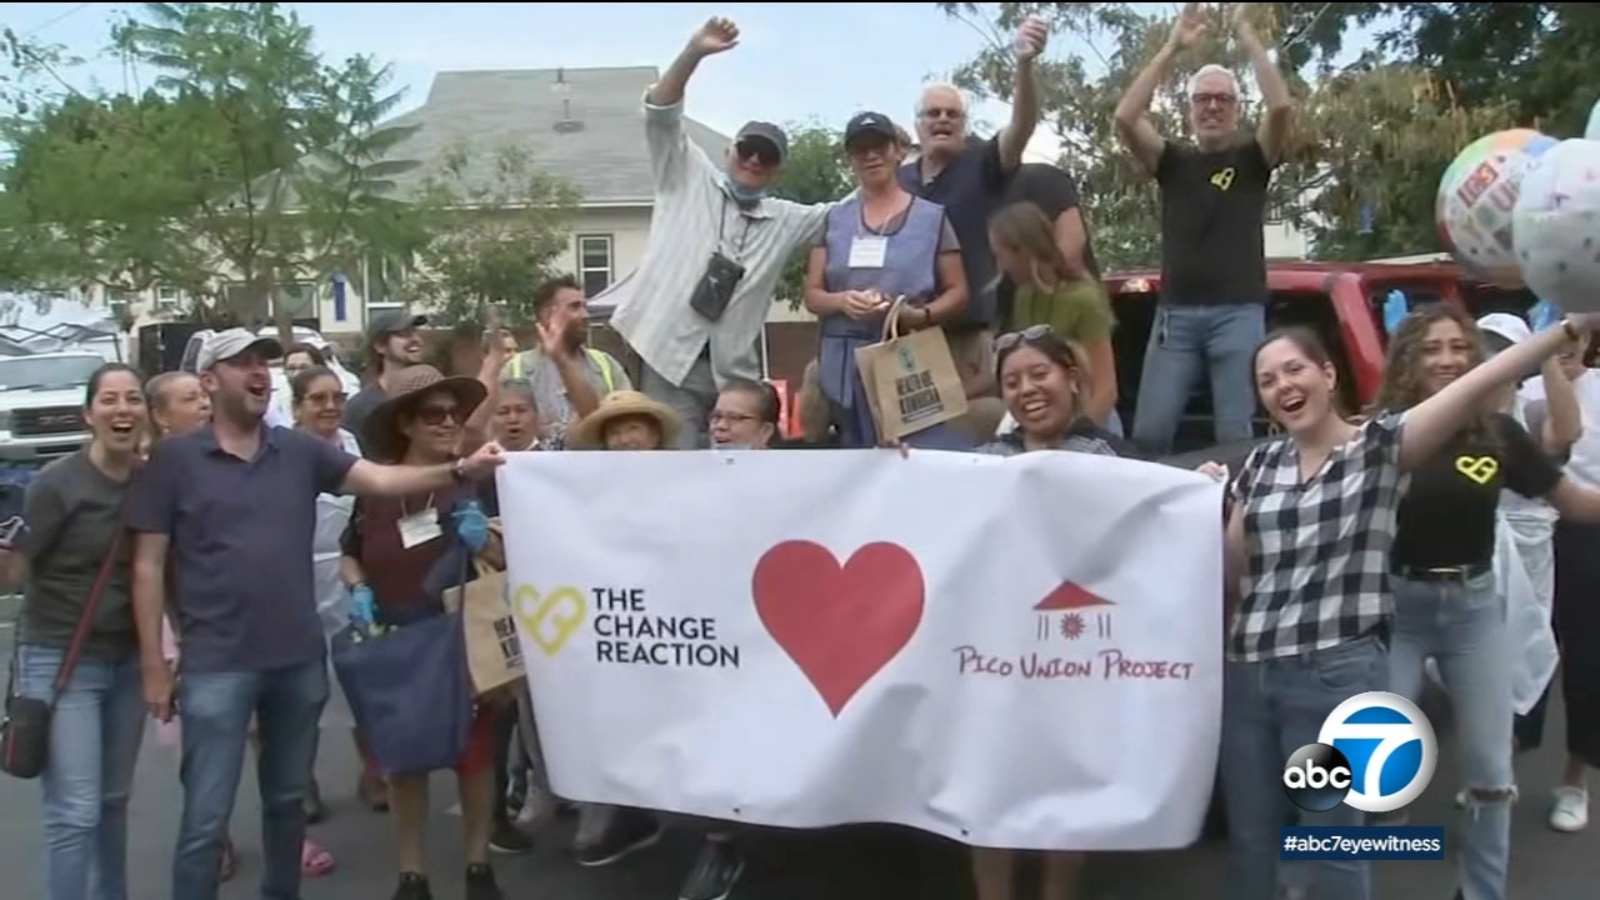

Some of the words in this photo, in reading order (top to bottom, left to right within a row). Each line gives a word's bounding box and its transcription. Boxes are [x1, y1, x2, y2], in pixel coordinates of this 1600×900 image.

[592, 588, 646, 611] THE
[593, 615, 717, 640] CHANGE
[596, 641, 740, 669] REACTION
[952, 645, 1014, 676] PICO
[1020, 652, 1092, 679] UNION
[1099, 648, 1195, 680] PROJECT
